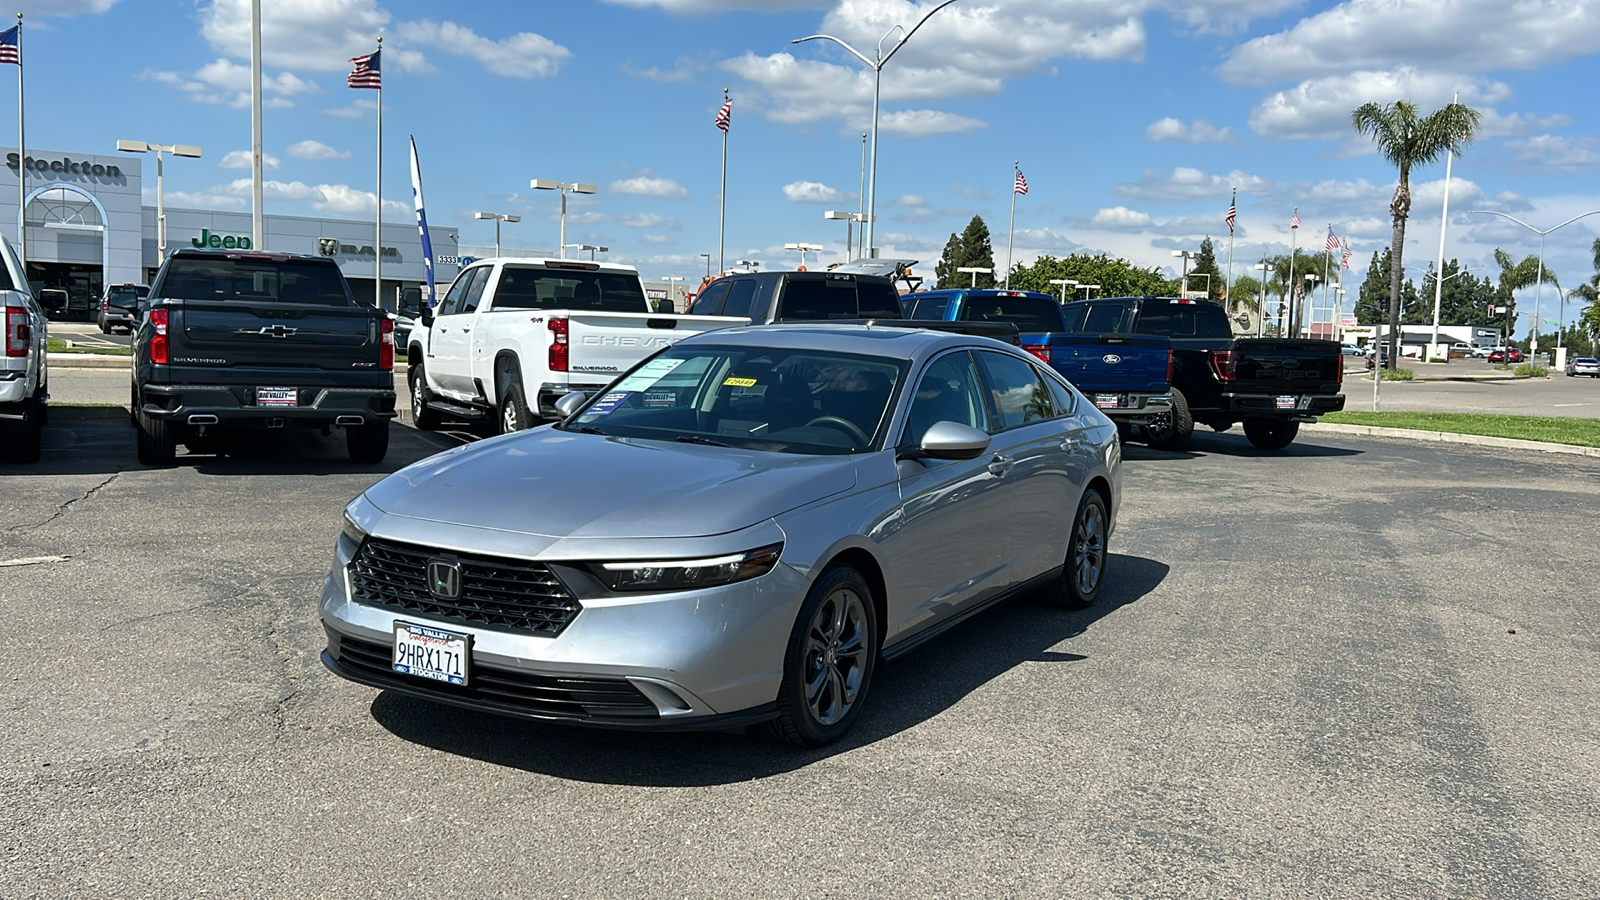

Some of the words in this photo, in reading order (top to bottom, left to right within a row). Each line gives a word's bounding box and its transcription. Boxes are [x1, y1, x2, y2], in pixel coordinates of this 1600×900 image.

[6, 153, 120, 178] Stockton
[192, 229, 251, 249] Jeep
[341, 245, 397, 256] RAM
[409, 626, 422, 634] BIG
[423, 628, 448, 639] VALLEY
[398, 641, 462, 676] 9HRX171
[409, 666, 449, 681] STOCKTON
